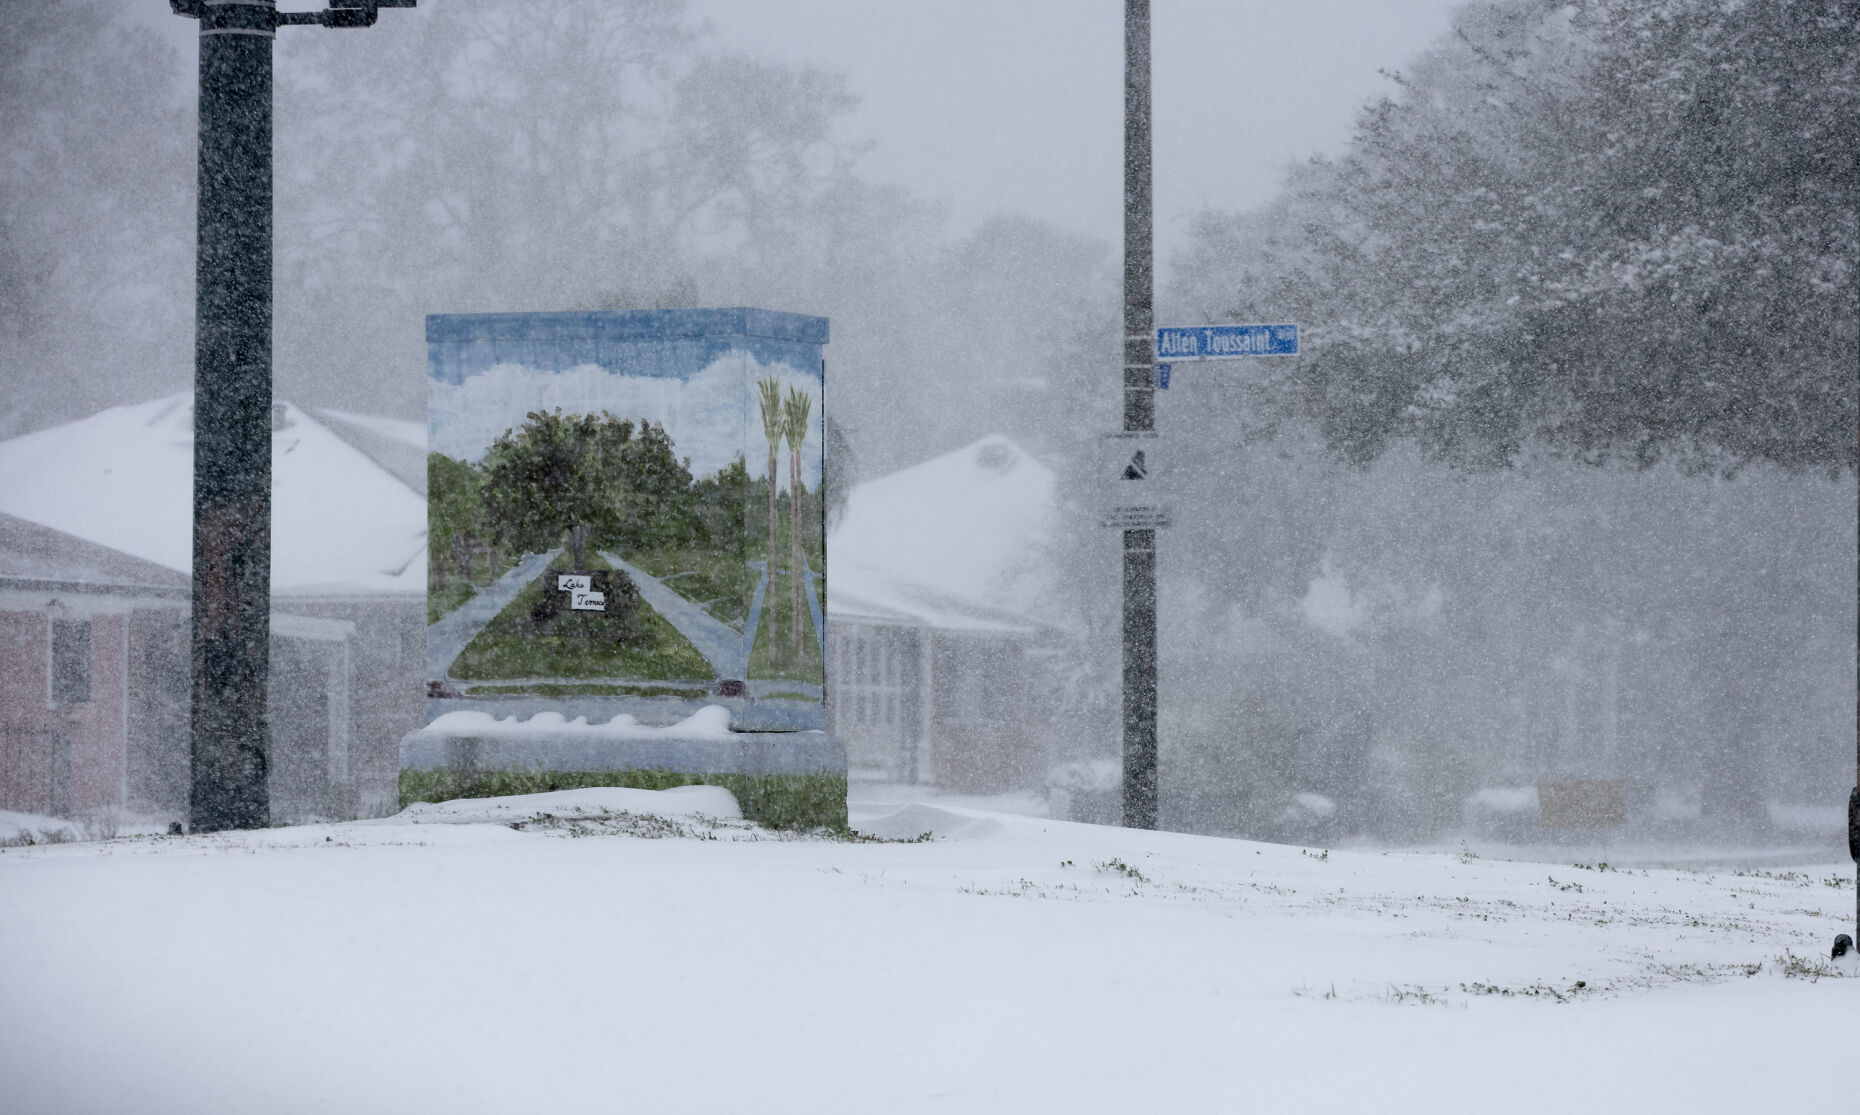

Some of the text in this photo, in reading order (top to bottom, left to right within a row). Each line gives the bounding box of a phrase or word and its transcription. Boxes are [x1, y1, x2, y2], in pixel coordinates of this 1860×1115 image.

[1161, 331, 1197, 354] Allen
[1204, 330, 1271, 352] Toussaint
[563, 578, 585, 590] Lake
